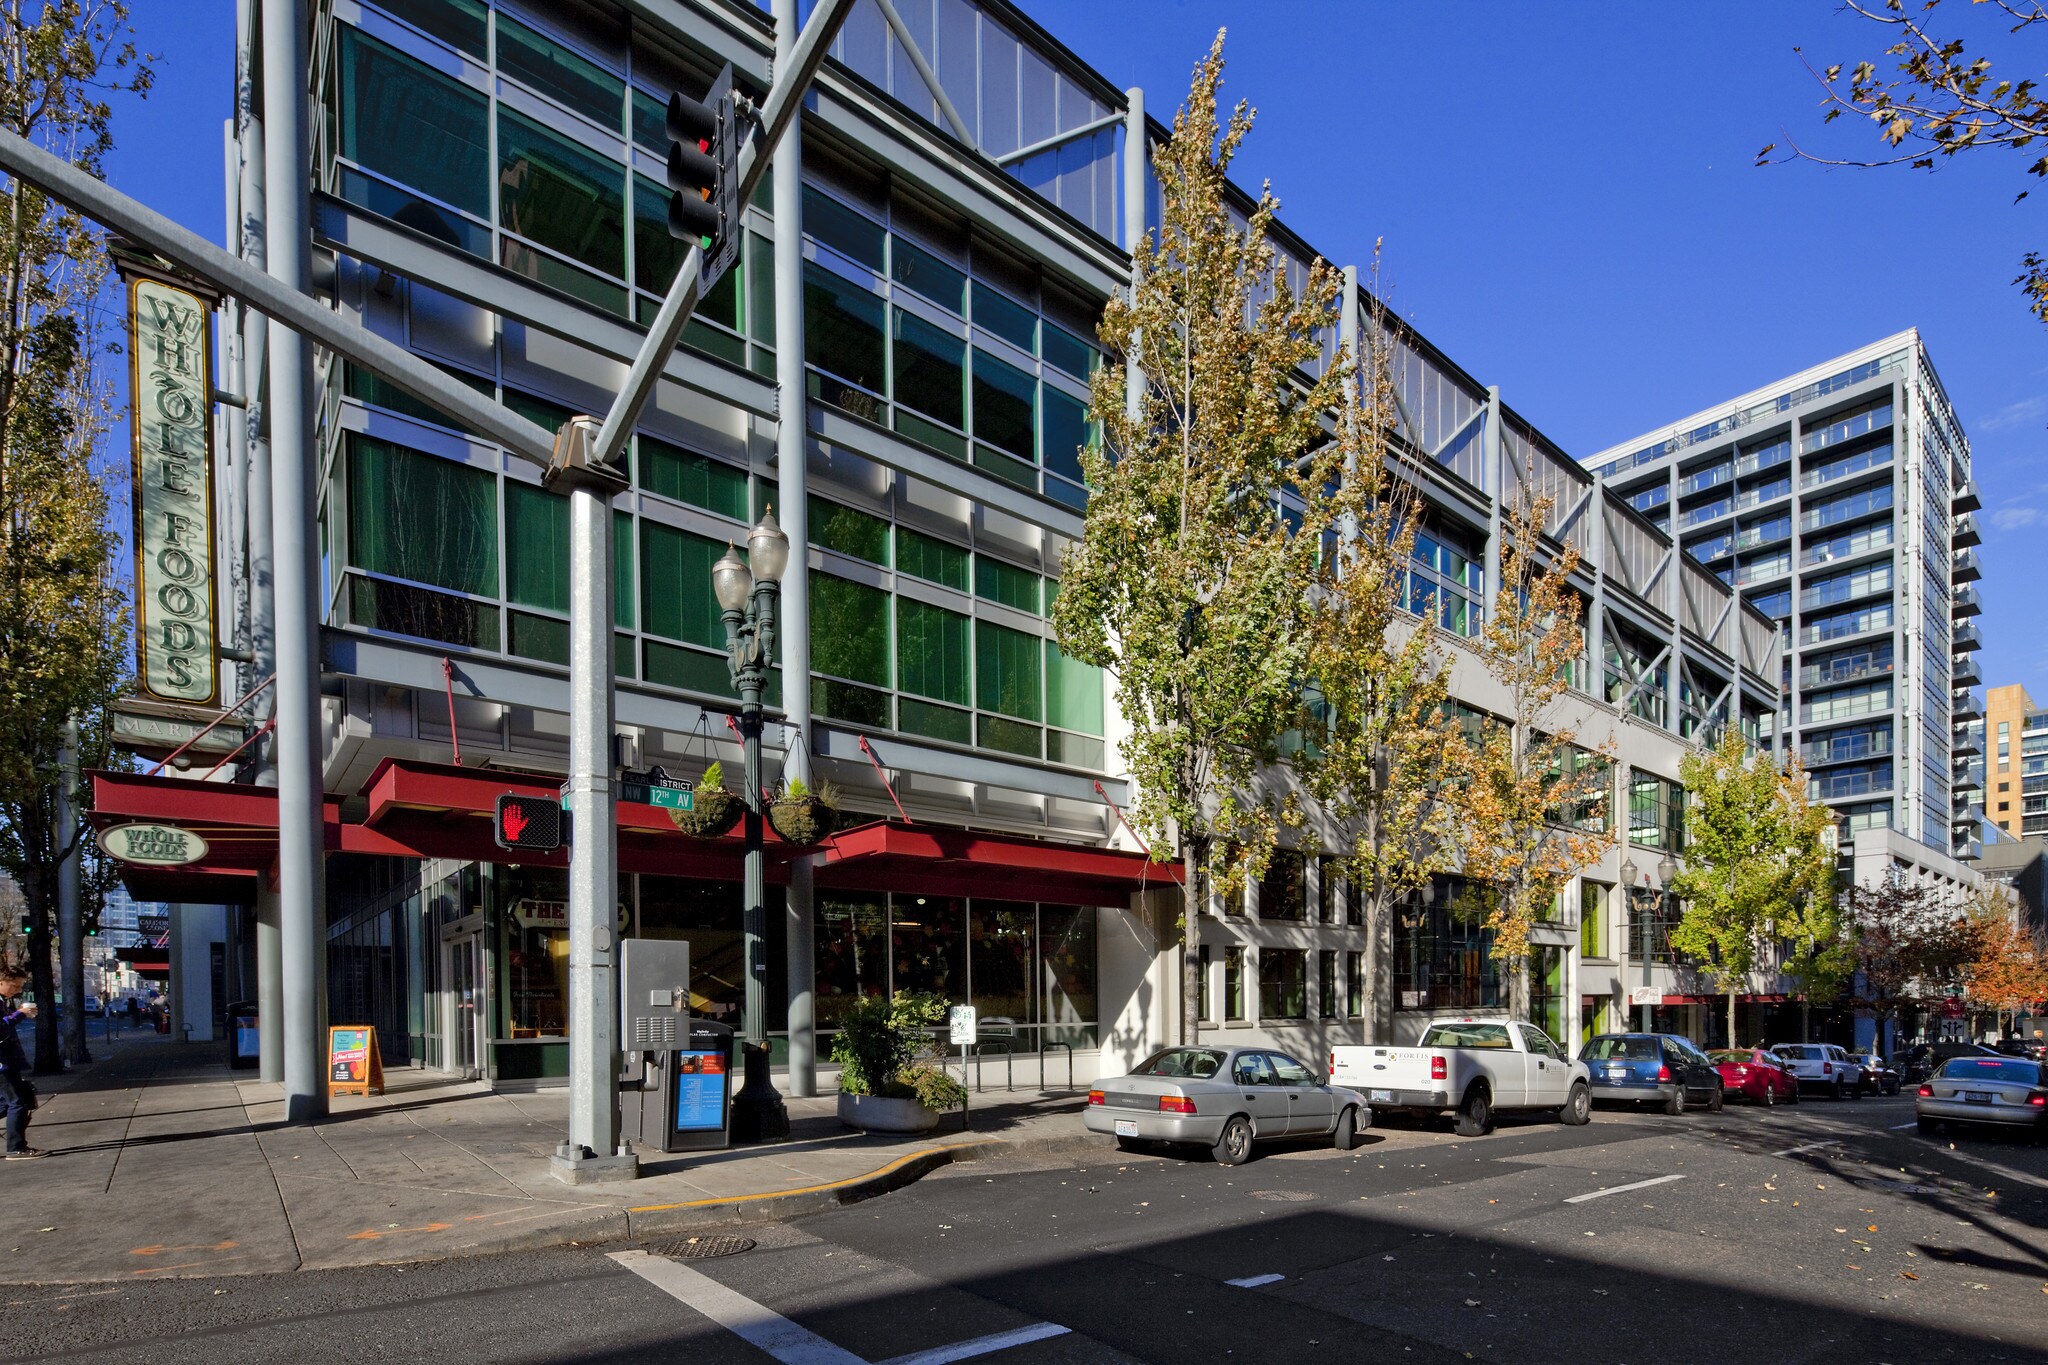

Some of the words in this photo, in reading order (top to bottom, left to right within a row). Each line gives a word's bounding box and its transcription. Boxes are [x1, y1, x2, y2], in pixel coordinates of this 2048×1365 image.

[143, 294, 195, 495] WHOLE
[156, 511, 198, 690] FOODS
[122, 718, 241, 743] MARKET
[623, 773, 651, 785] PEARL
[654, 778, 692, 791] DISTRICT
[625, 786, 641, 800] NW
[651, 789, 670, 804] 12TH
[677, 793, 690, 807] AV
[123, 826, 188, 844] WHOLE
[127, 841, 188, 855] FOODS
[521, 901, 565, 919] THE
